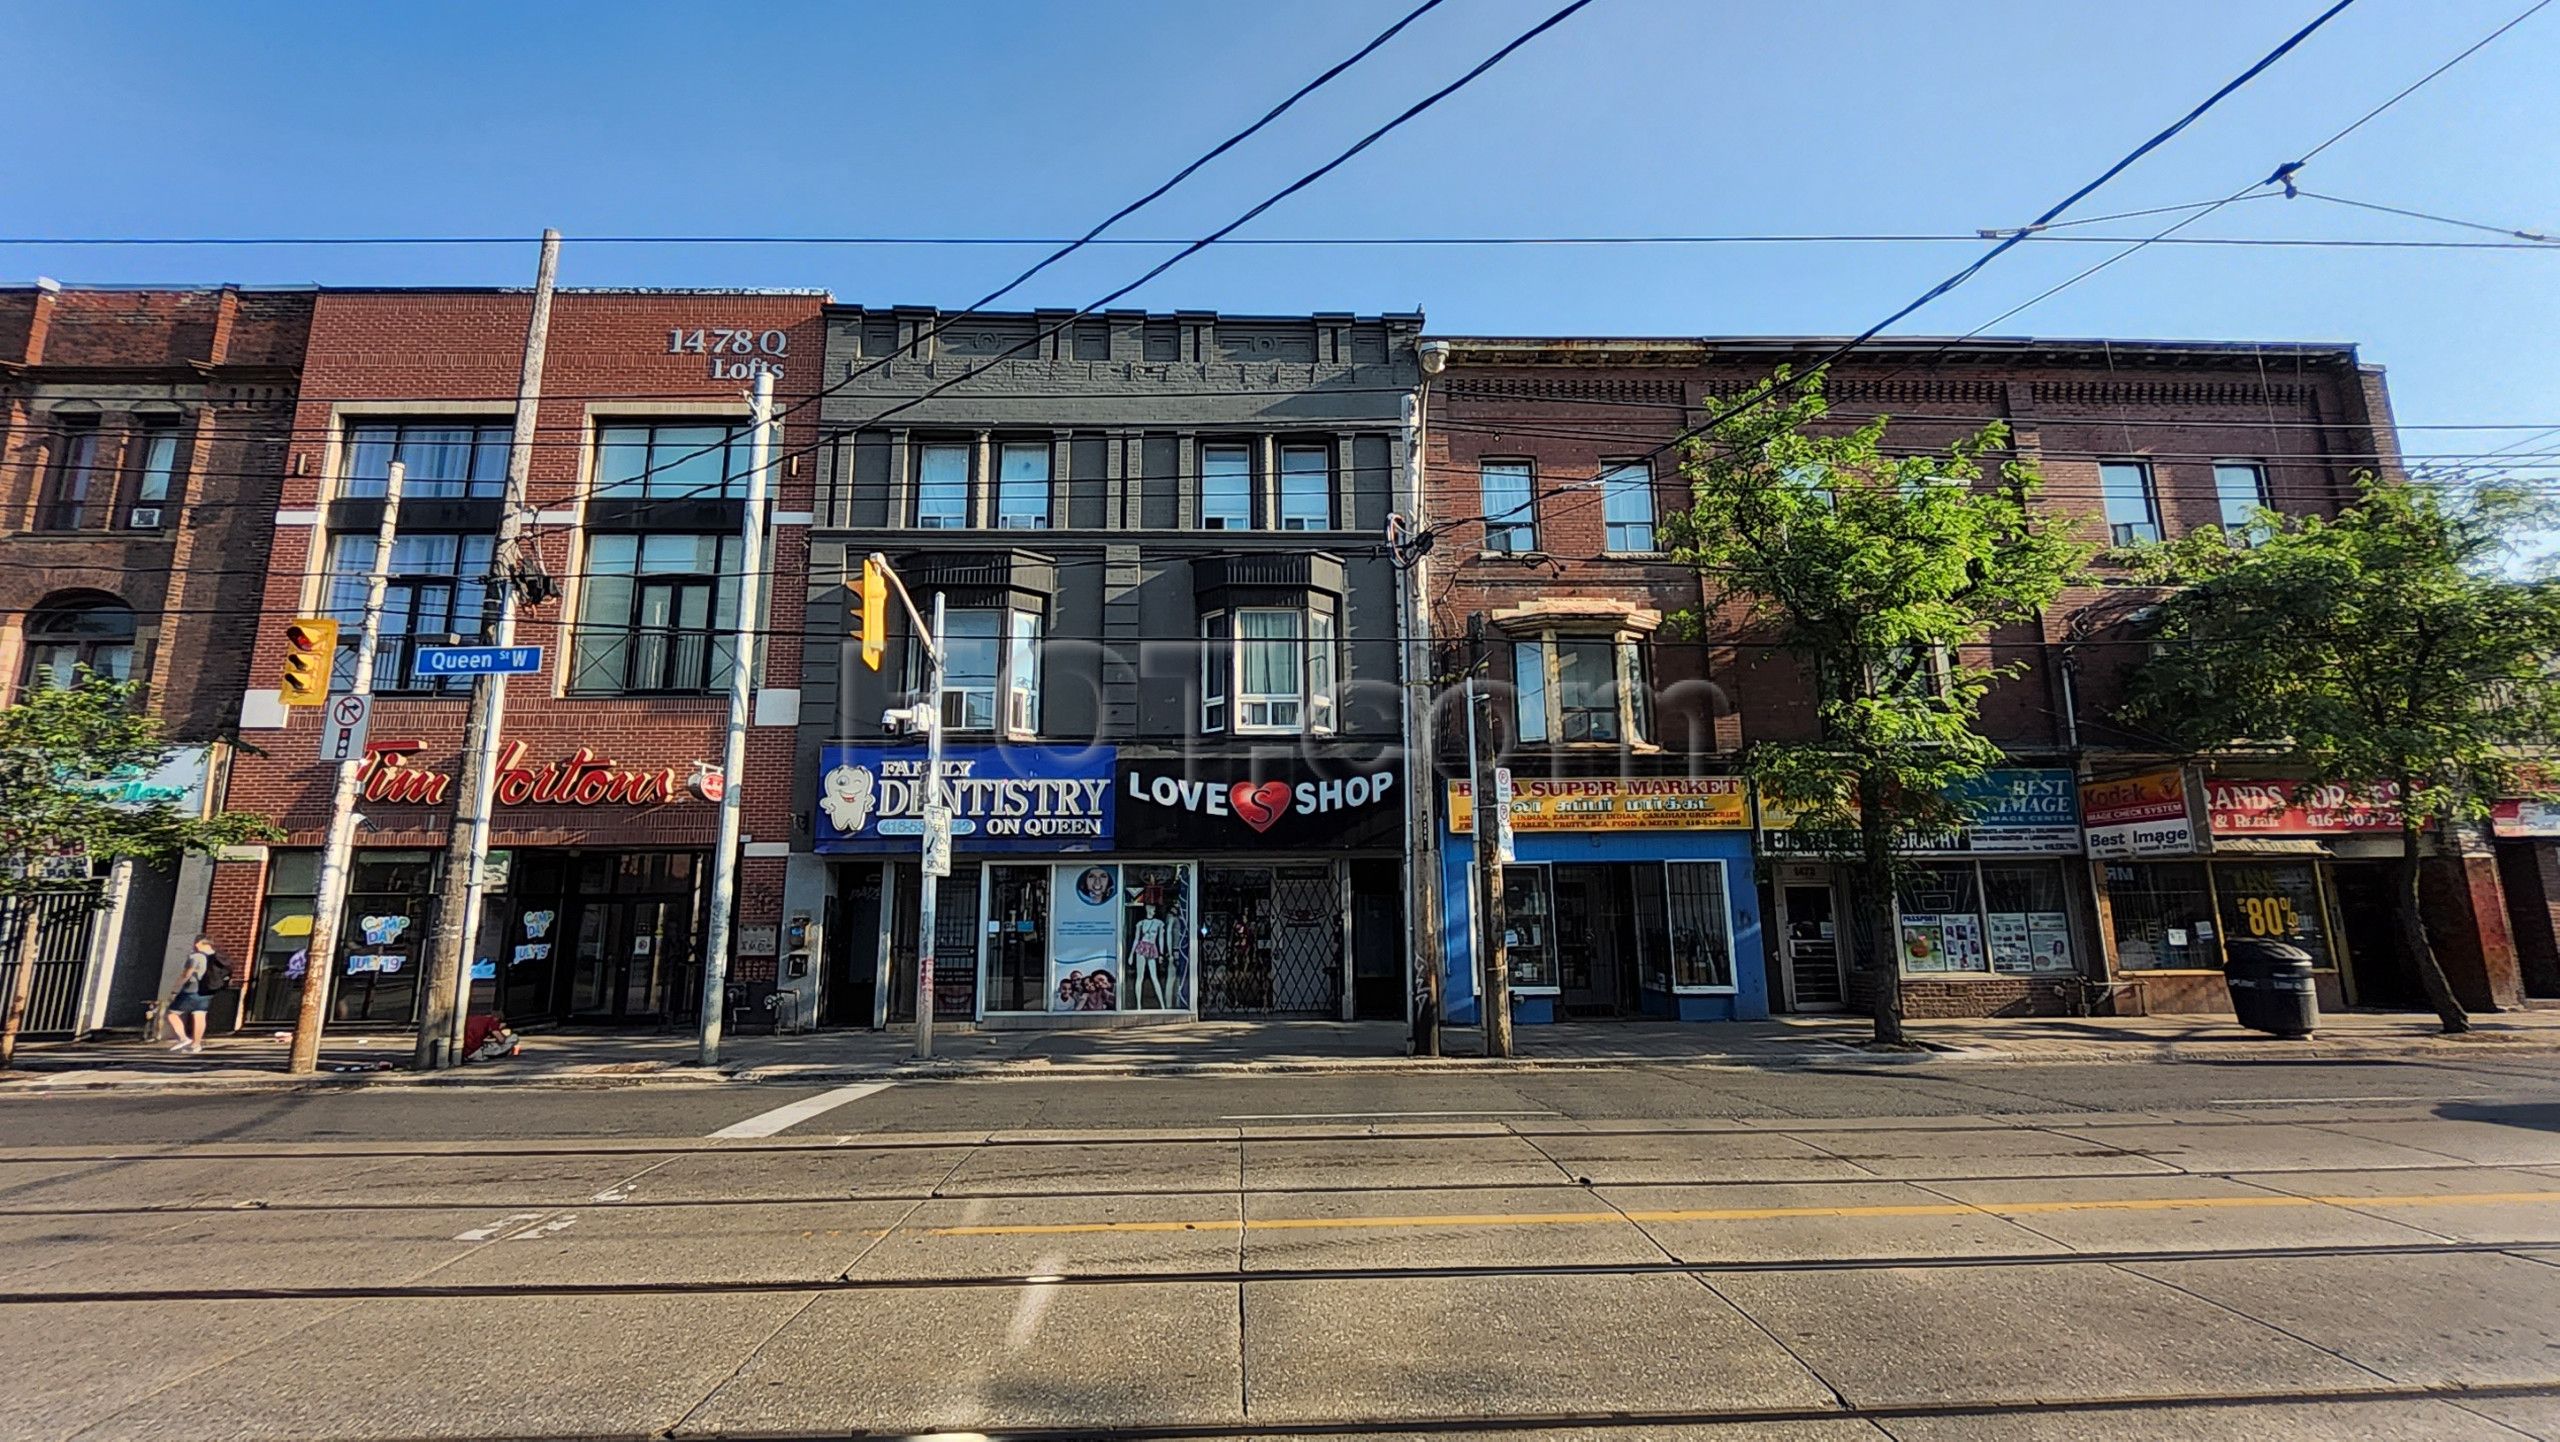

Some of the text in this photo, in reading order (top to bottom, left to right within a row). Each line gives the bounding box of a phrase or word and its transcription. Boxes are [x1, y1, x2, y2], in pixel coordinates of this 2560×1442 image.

[669, 327, 789, 358] 1478 Q
[712, 357, 785, 379] Lofts
[431, 650, 528, 670] Queen St W
[1129, 771, 1230, 818] LOVE
[1295, 771, 1395, 816] SHOP
[1530, 781, 1618, 797] SUPER
[1626, 779, 1740, 796] MARKET
[2012, 779, 2067, 796] BEST
[2083, 782, 2147, 806] Kodak
[1998, 796, 2072, 813] IMAGE
[2113, 807, 2142, 818] CHECK
[2144, 802, 2183, 816] SYSTEM
[1648, 819, 1680, 827] MEATS
[1986, 814, 2074, 822] IMAGE CENTER
[2214, 814, 2230, 829] &
[986, 818, 1101, 836] ON QUEEN
[2090, 832, 2126, 848] Best
[2132, 828, 2188, 844] Image
[361, 914, 410, 931] CAMP
[523, 909, 554, 926] CAMP
[1902, 915, 1938, 925] PASSPORT
[2246, 896, 2299, 936] 80%
[366, 929, 398, 945] DAY
[526, 923, 549, 939] DAY
[513, 943, 552, 964] JULY 19
[348, 954, 406, 975] JULY 19
